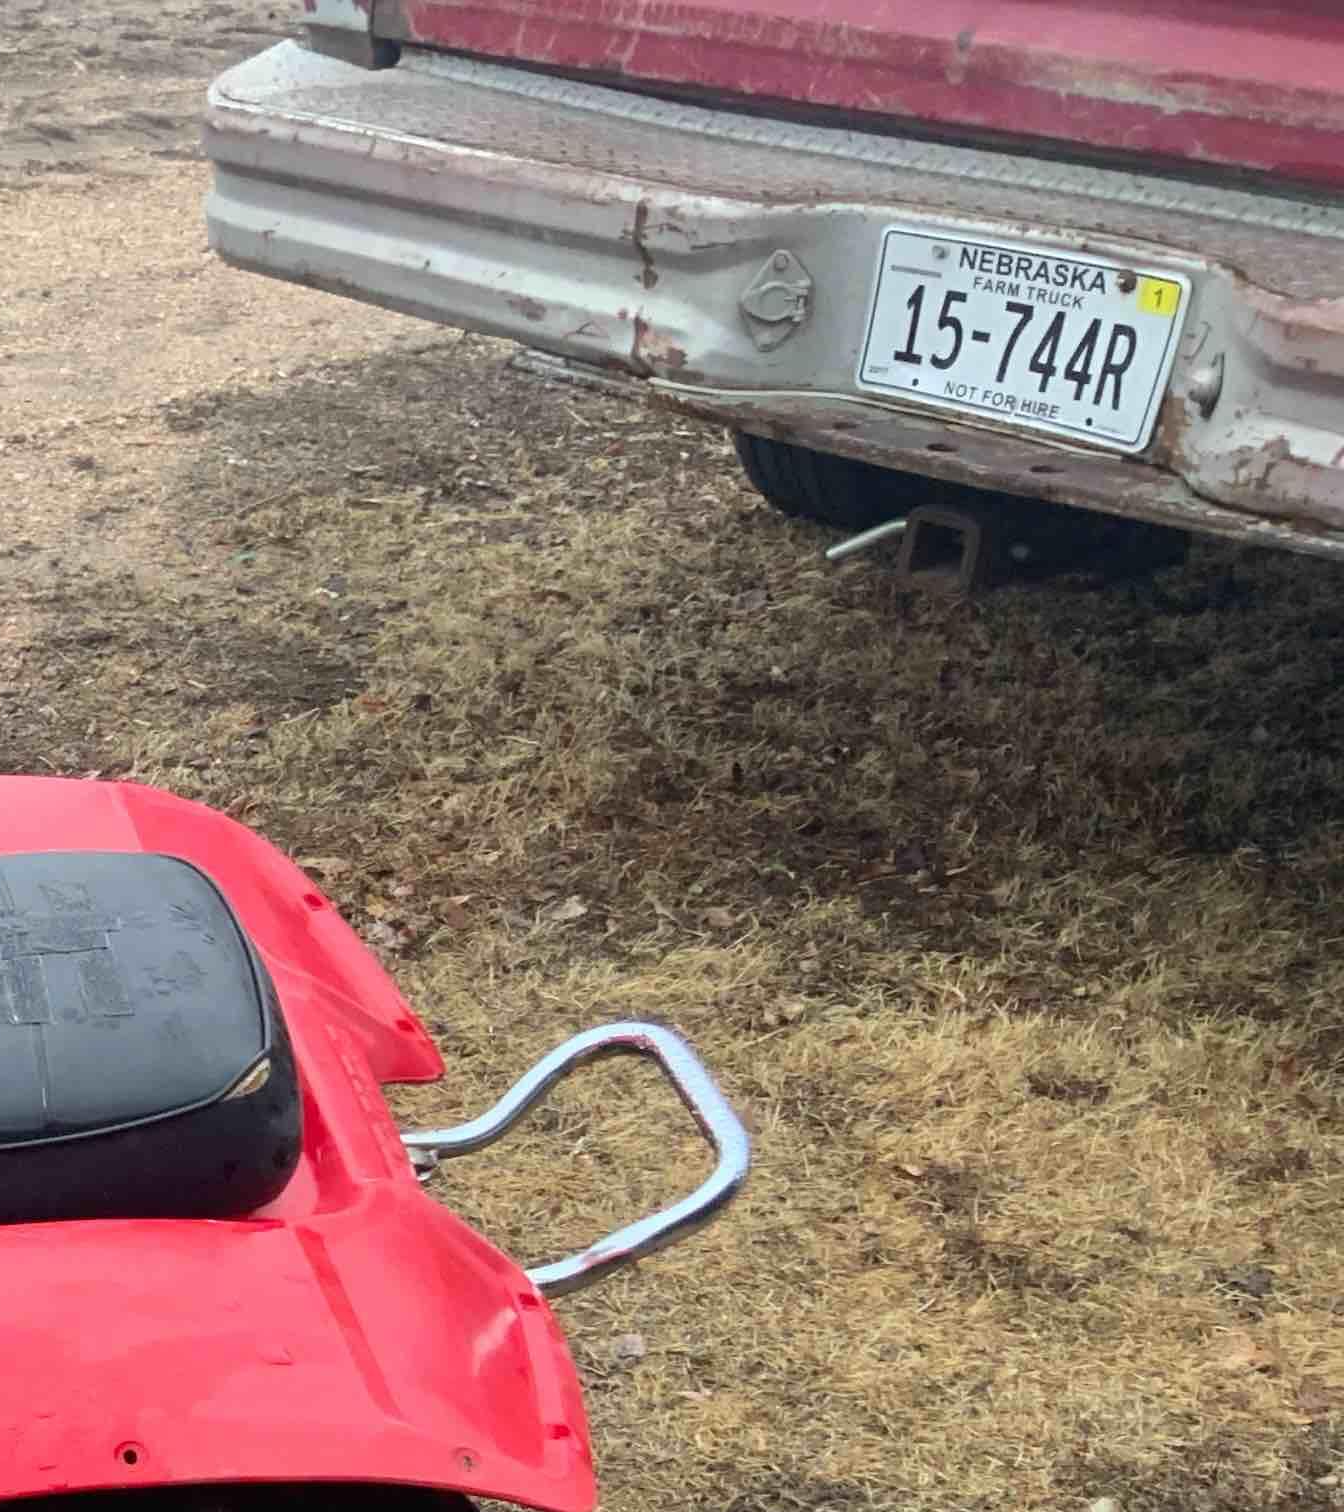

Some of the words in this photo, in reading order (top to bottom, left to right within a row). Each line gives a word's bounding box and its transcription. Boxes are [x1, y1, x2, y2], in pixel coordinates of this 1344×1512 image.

[959, 246, 1106, 295] NEBRASKA
[972, 276, 1020, 298] FARM
[1027, 285, 1085, 311] TRUCK
[1152, 287, 1164, 308] 1
[893, 284, 1138, 411] 15-744R
[943, 380, 977, 400] NOT
[982, 390, 1014, 409] FOR
[1020, 400, 1061, 419] HIRE
